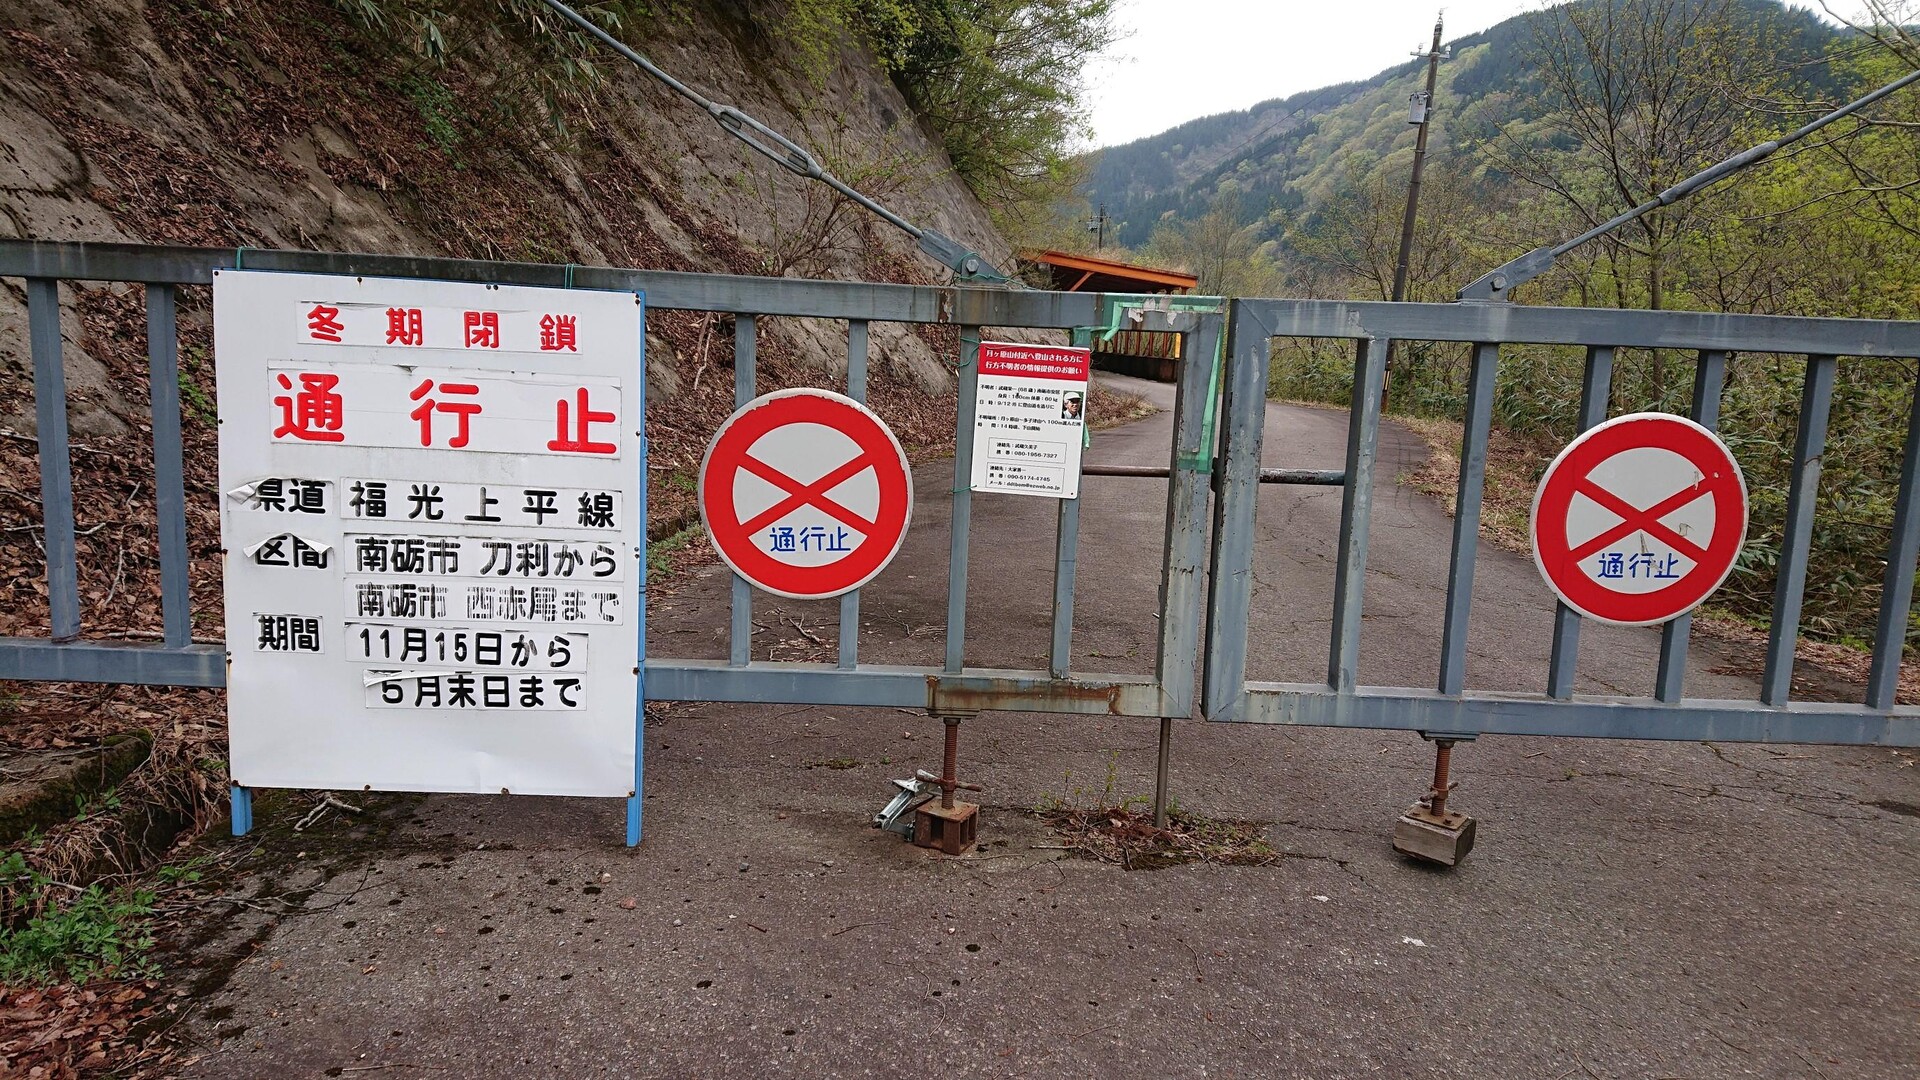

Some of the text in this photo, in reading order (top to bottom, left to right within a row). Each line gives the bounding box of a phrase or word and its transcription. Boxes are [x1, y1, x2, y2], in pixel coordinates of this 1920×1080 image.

[307, 304, 577, 352] 冬期閉鎖
[985, 361, 1082, 374] 行方不明者の情報提供のお願い
[273, 373, 617, 454] 通行止
[255, 478, 615, 528] 県道 福光上平線
[255, 535, 328, 570] 区間
[480, 541, 617, 578] 刀利から
[769, 526, 851, 551] 通行止
[1597, 553, 1680, 578] 通行止
[257, 615, 572, 667] 期間 11月15日から
[381, 675, 581, 708] 5月末日まで
